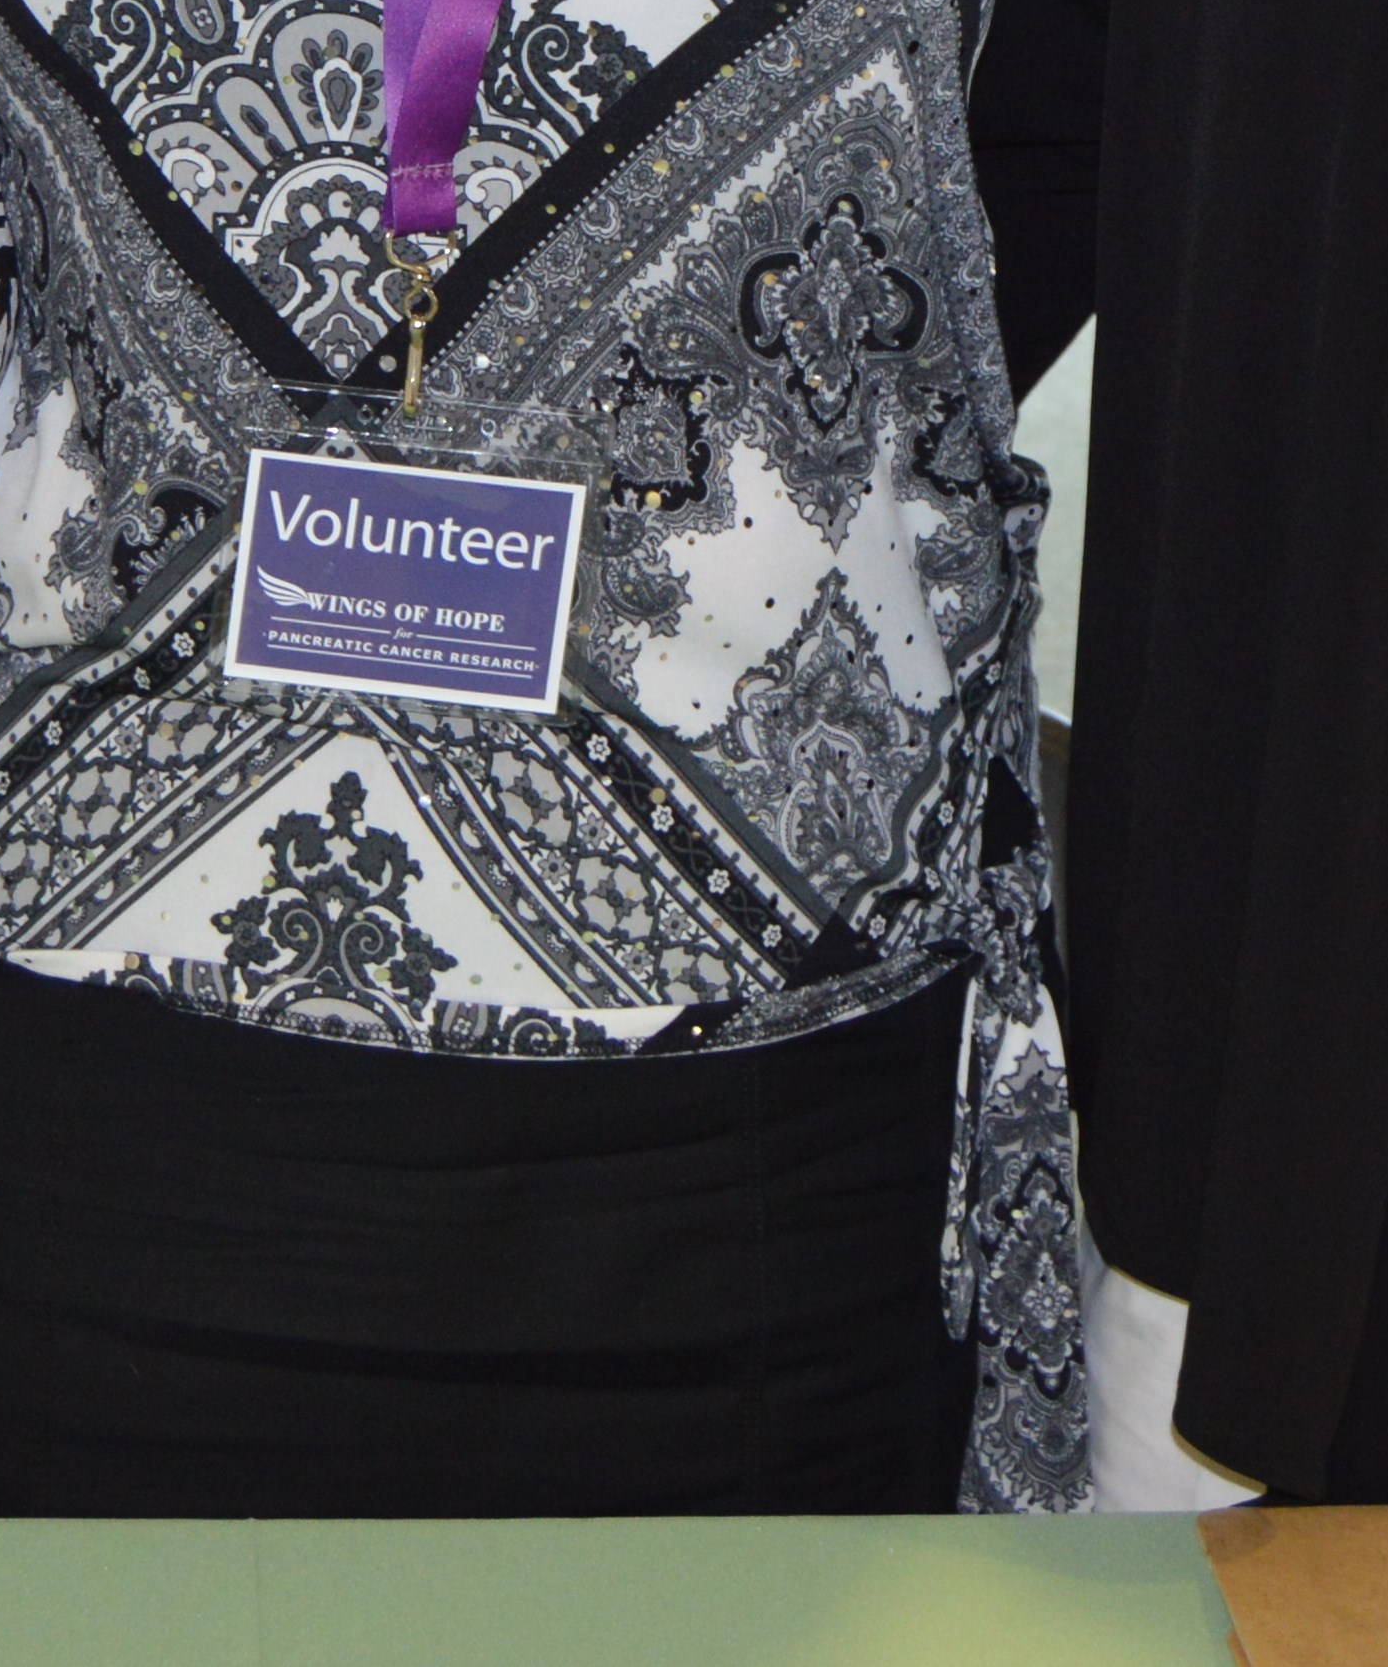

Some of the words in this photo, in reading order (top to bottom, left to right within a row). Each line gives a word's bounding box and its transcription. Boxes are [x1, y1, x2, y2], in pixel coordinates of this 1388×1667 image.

[269, 490, 554, 572] Volunteer
[307, 592, 387, 619] WINGS
[394, 603, 428, 623] OF
[435, 608, 505, 633] HOPE
[268, 630, 373, 653] PANCREATIC
[379, 644, 443, 662] CANCER
[450, 652, 535, 672] RESEARCH
[393, 628, 413, 640] for
